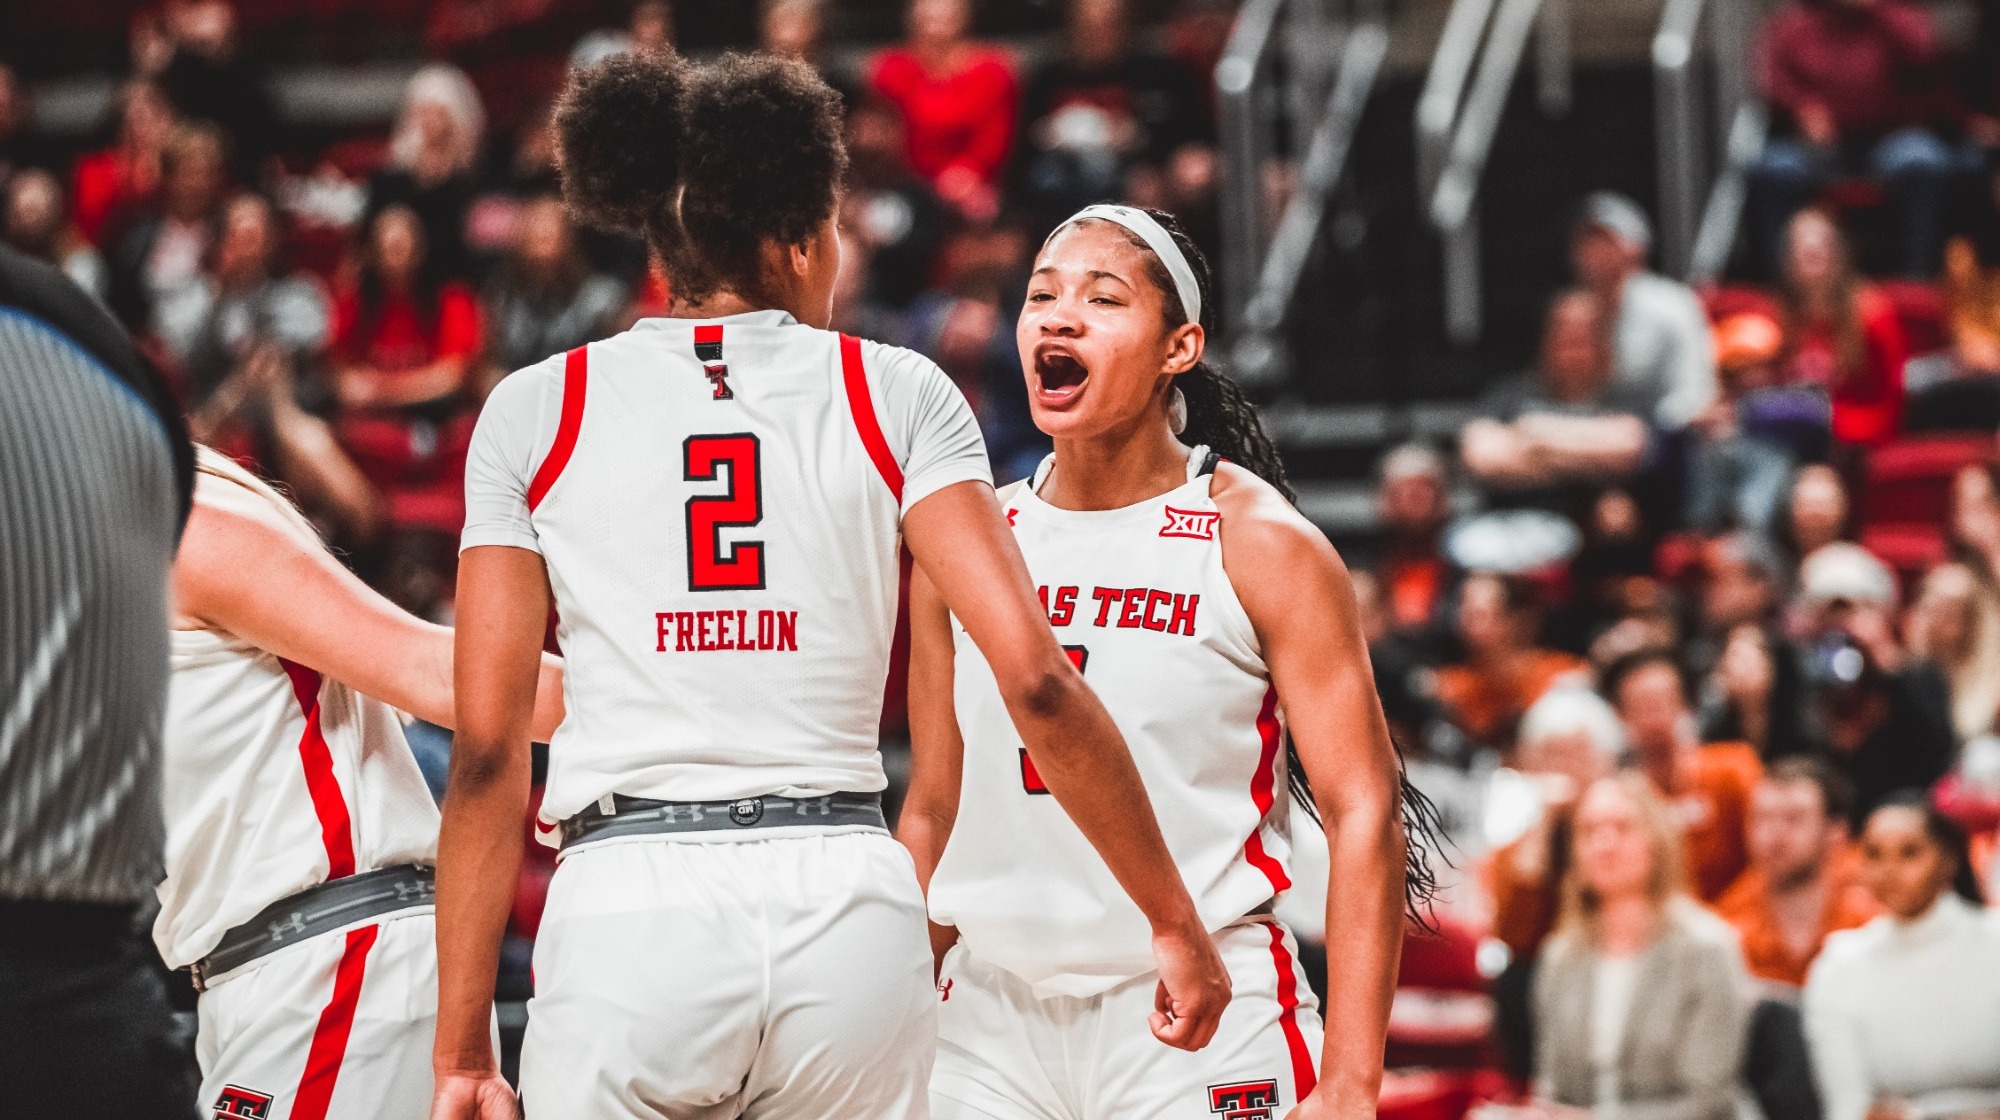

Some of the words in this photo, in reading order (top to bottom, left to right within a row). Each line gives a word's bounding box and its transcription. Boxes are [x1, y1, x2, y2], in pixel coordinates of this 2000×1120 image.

[683, 432, 766, 592] 2
[1160, 508, 1219, 539] XII
[656, 610, 798, 652] FREELON
[1092, 586, 1200, 636] TECH
